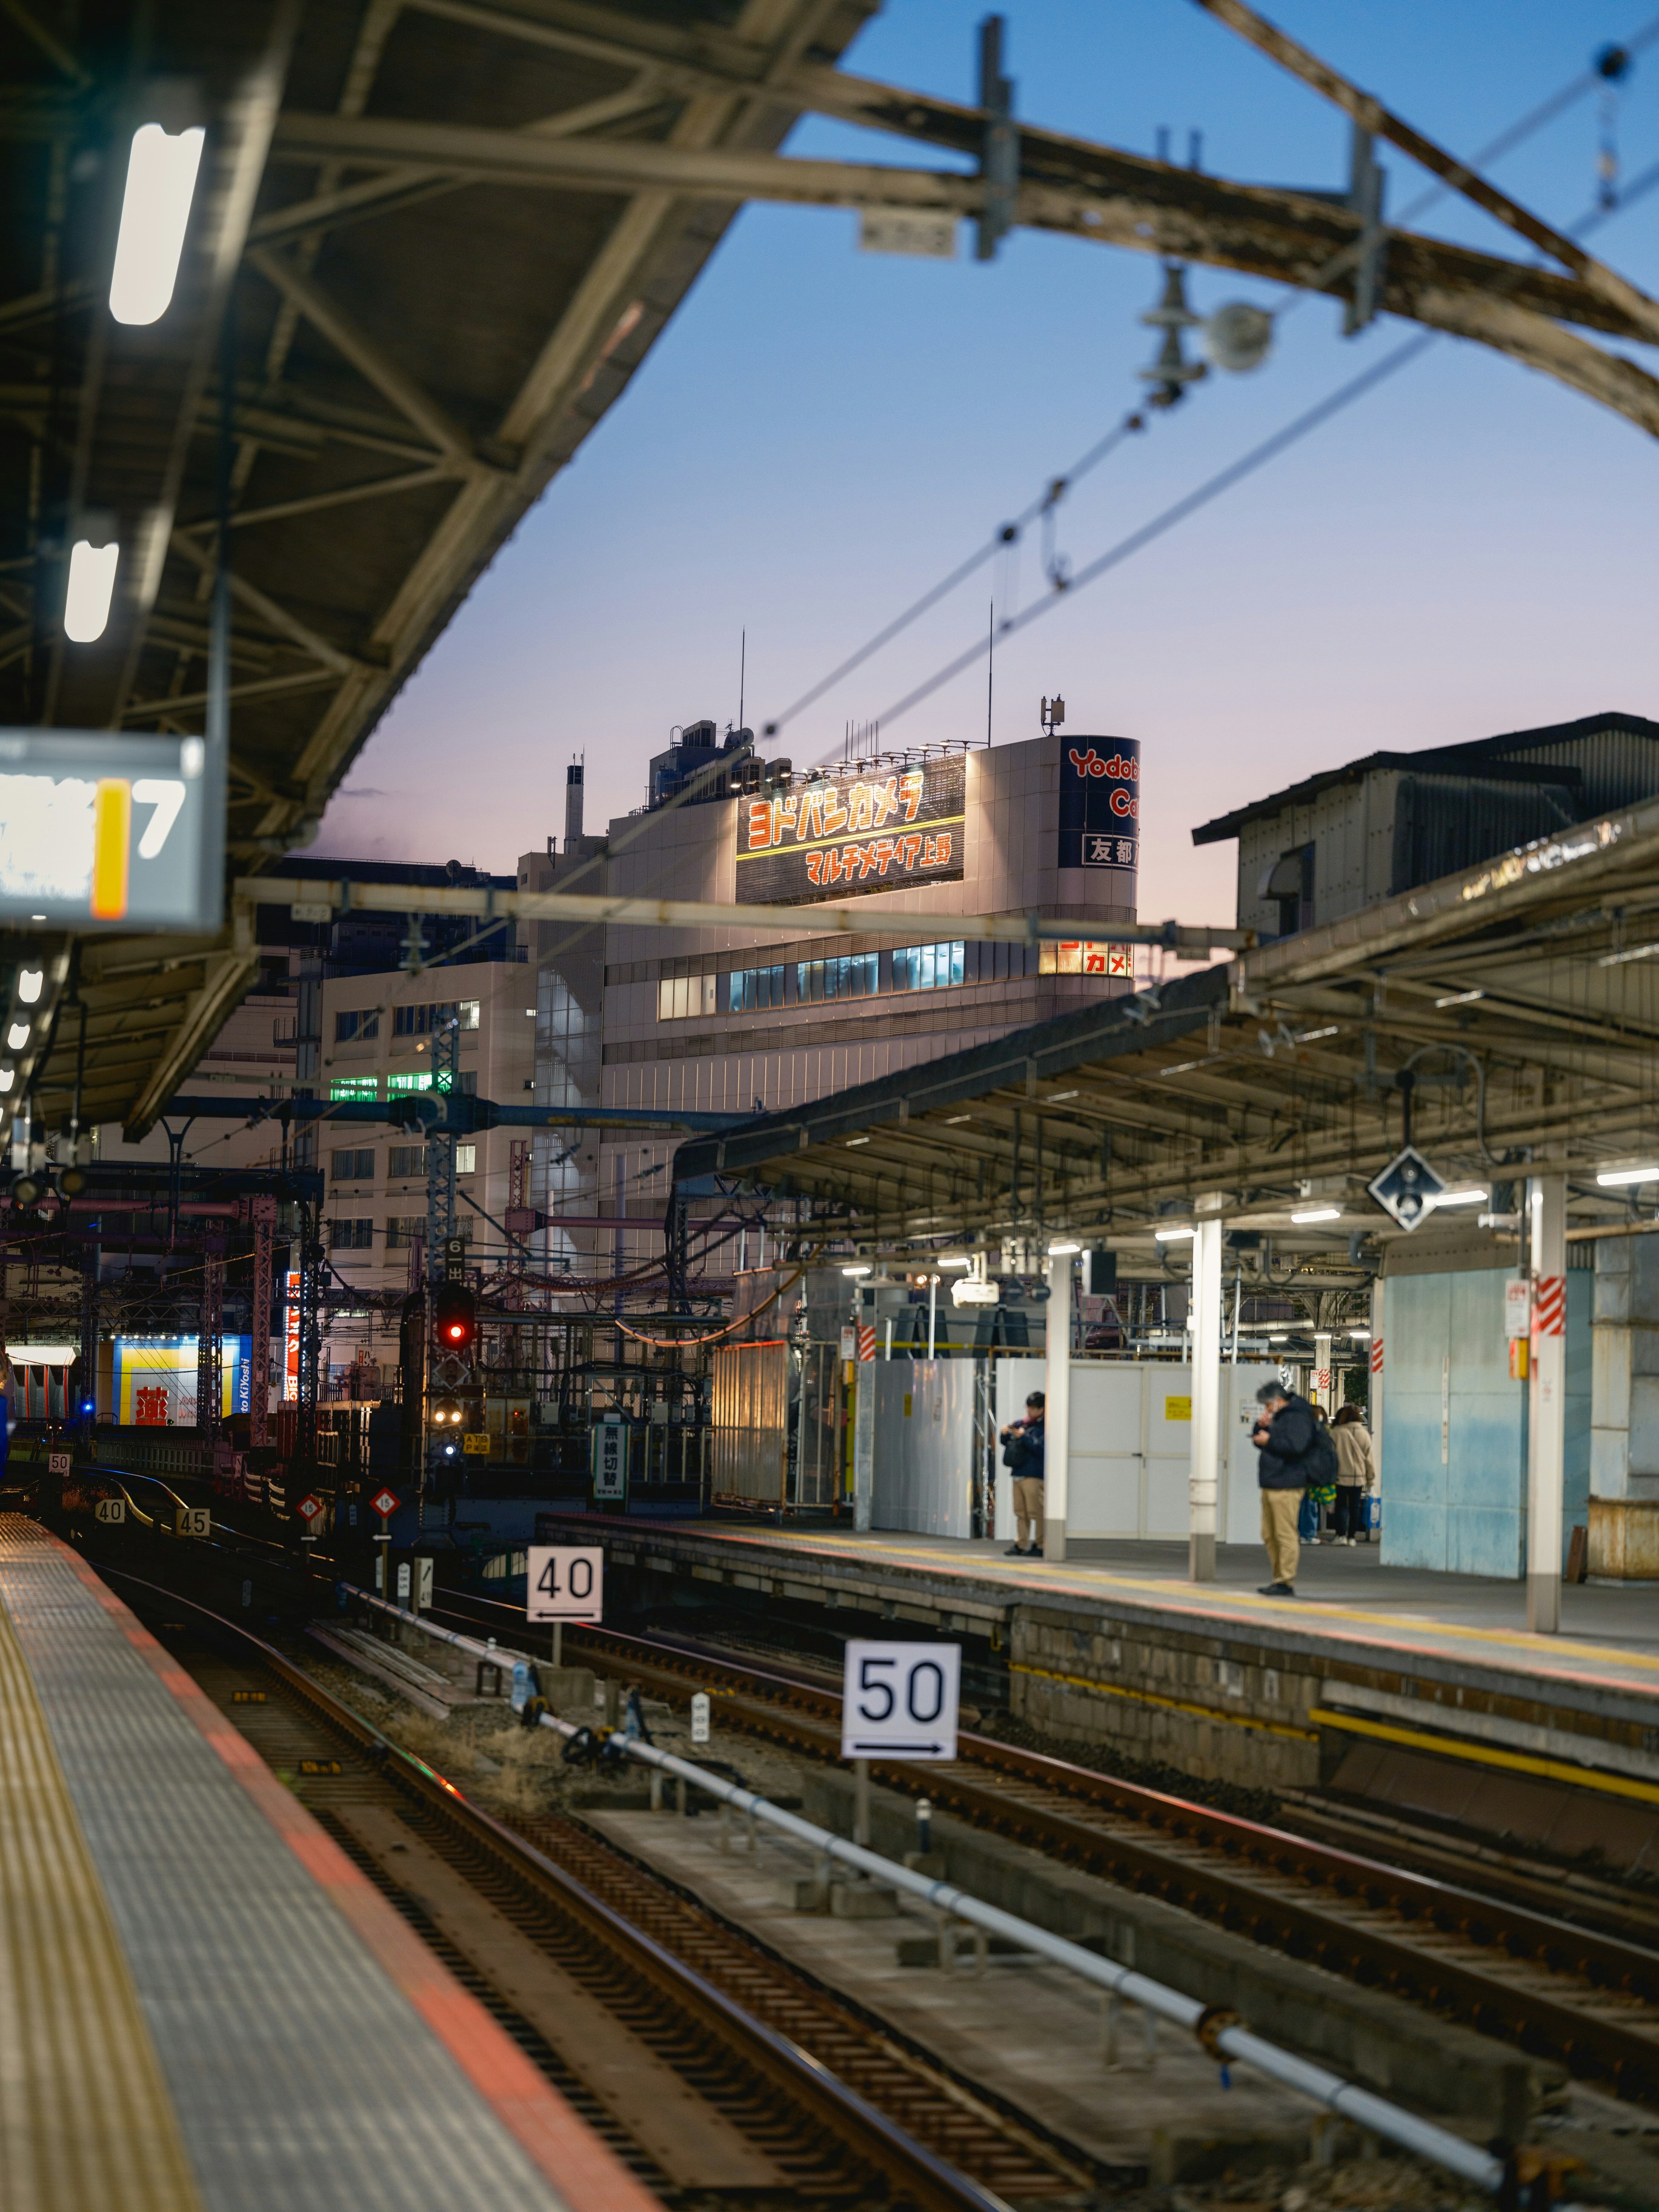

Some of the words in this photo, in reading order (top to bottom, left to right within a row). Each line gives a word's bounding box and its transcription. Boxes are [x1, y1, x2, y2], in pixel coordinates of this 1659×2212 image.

[1069, 748, 1139, 782] Yodob
[748, 770, 924, 850] ヨドバシカメラ
[1109, 788, 1139, 819] Ca
[131, 779, 186, 860] 7
[805, 832, 952, 886] マルチメディア上野
[1086, 954, 1131, 973] カメ
[52, 1456, 67, 1469] 50
[99, 1502, 121, 1521] 40
[305, 1504, 313, 1512] 15
[381, 1498, 390, 1508] 15
[181, 1512, 205, 1533] 45
[536, 1556, 594, 1600] 40
[857, 1658, 944, 1724] 50
